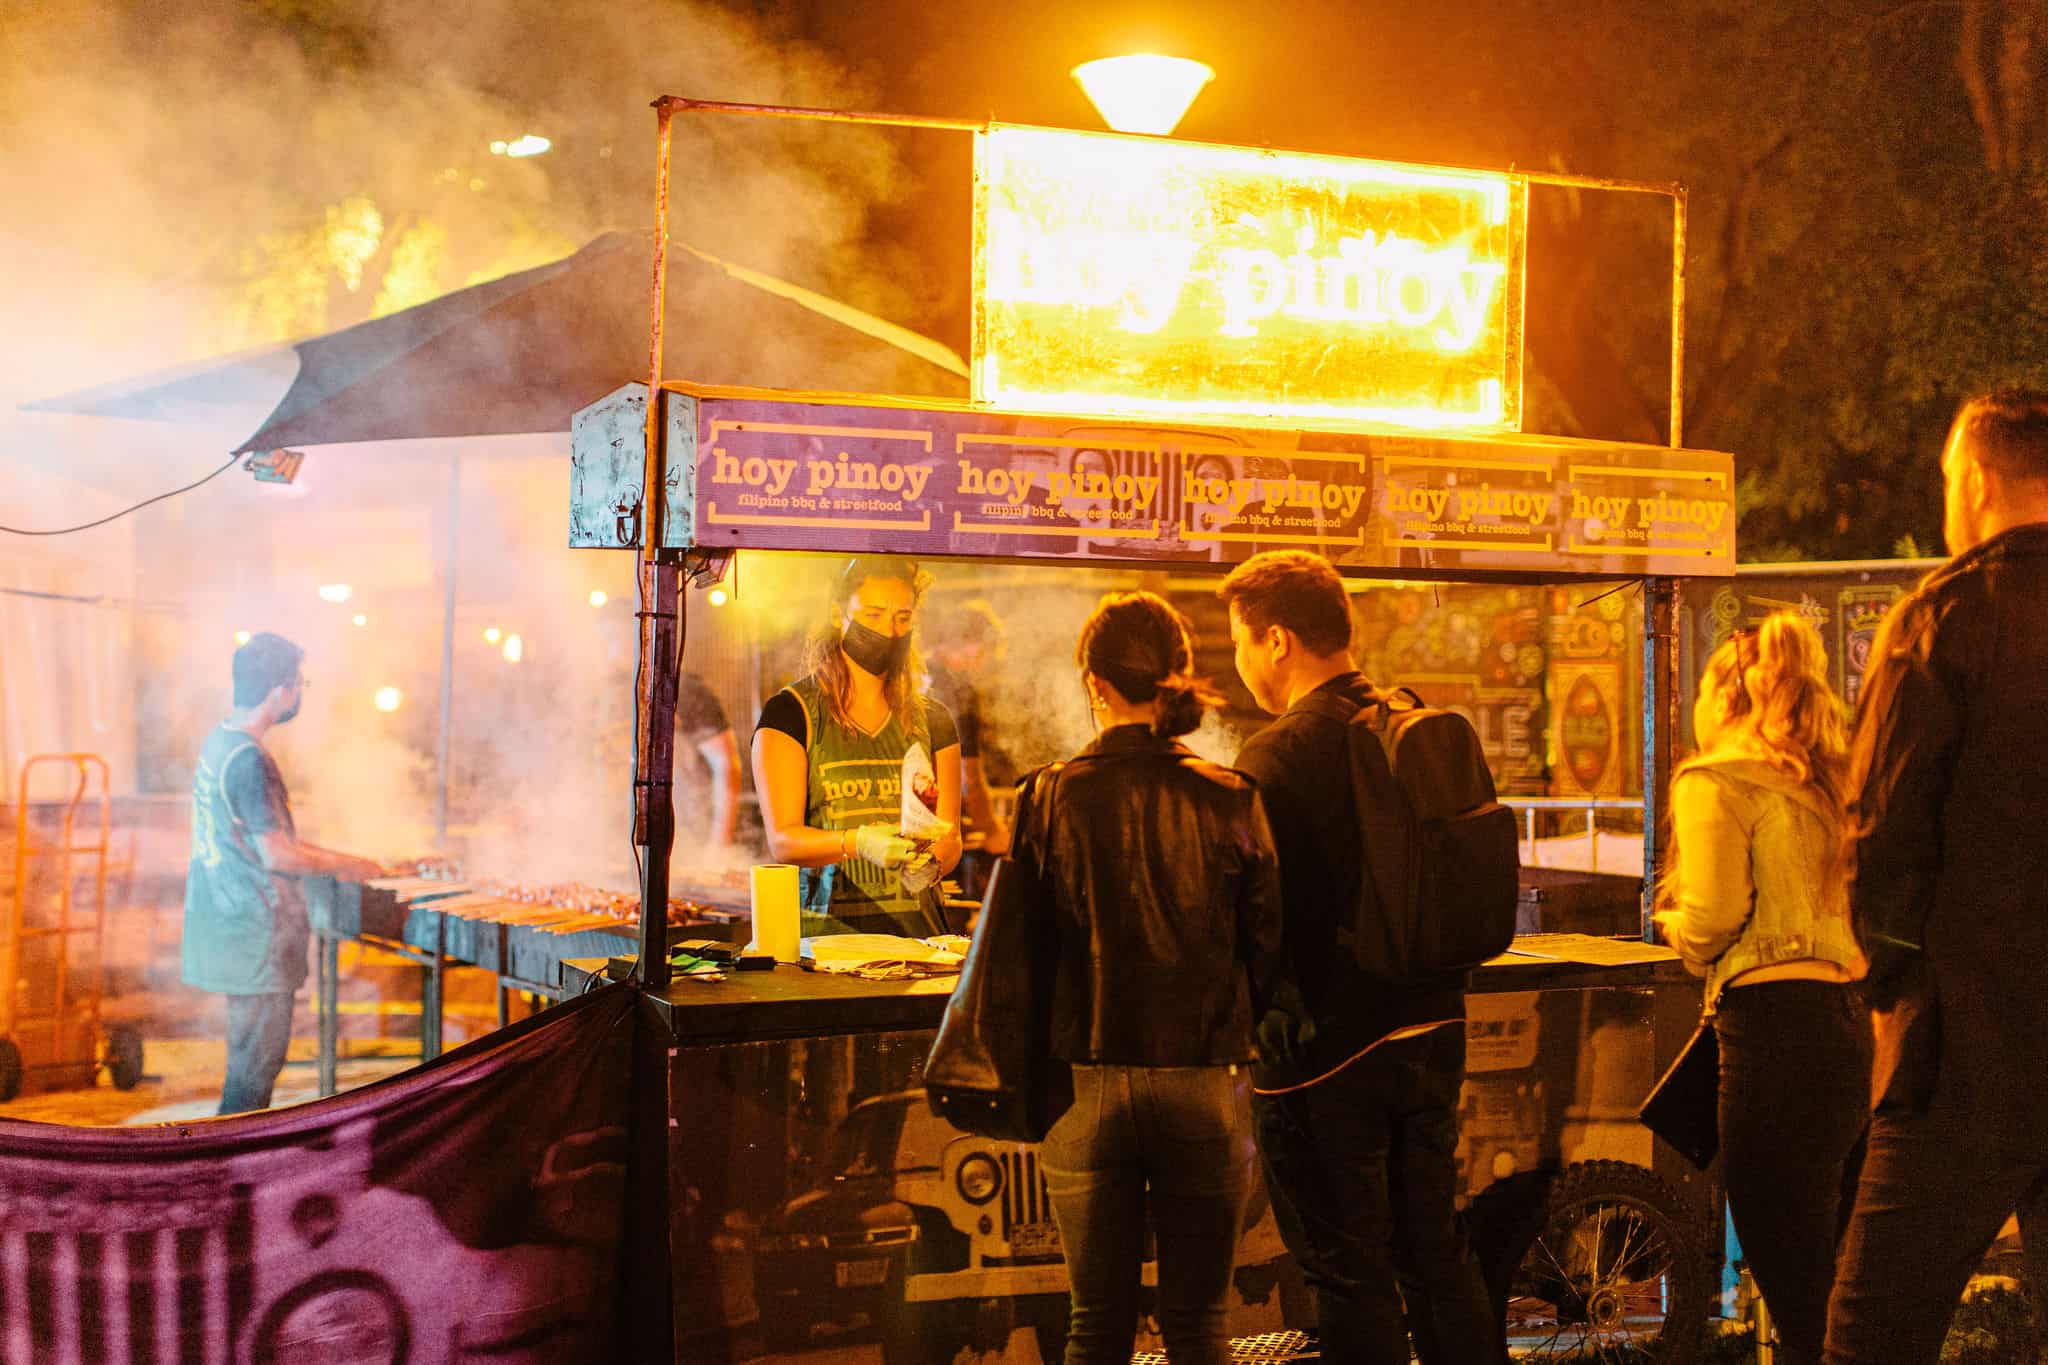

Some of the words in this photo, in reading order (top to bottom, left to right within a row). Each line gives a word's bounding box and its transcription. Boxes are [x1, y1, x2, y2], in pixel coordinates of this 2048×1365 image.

[1215, 222, 1505, 351] pinoy
[711, 448, 798, 495] hoy
[806, 452, 933, 501] pinoy
[957, 460, 1038, 505] hoy
[1045, 464, 1161, 510] pinoy
[1183, 470, 1252, 513] hoy
[1261, 473, 1366, 518] pinoy
[738, 494, 789, 509] filipino
[791, 495, 816, 510] bbq
[818, 498, 832, 509] &
[833, 497, 903, 512] streetfood
[1032, 505, 1054, 519] bbq
[1057, 507, 1068, 518] &
[1249, 514, 1270, 527] bbq
[1271, 515, 1283, 527] &
[1385, 480, 1451, 521] hoy
[1456, 482, 1553, 525] pinoy
[1571, 488, 1631, 528] hoy
[1637, 490, 1728, 531] pinoy
